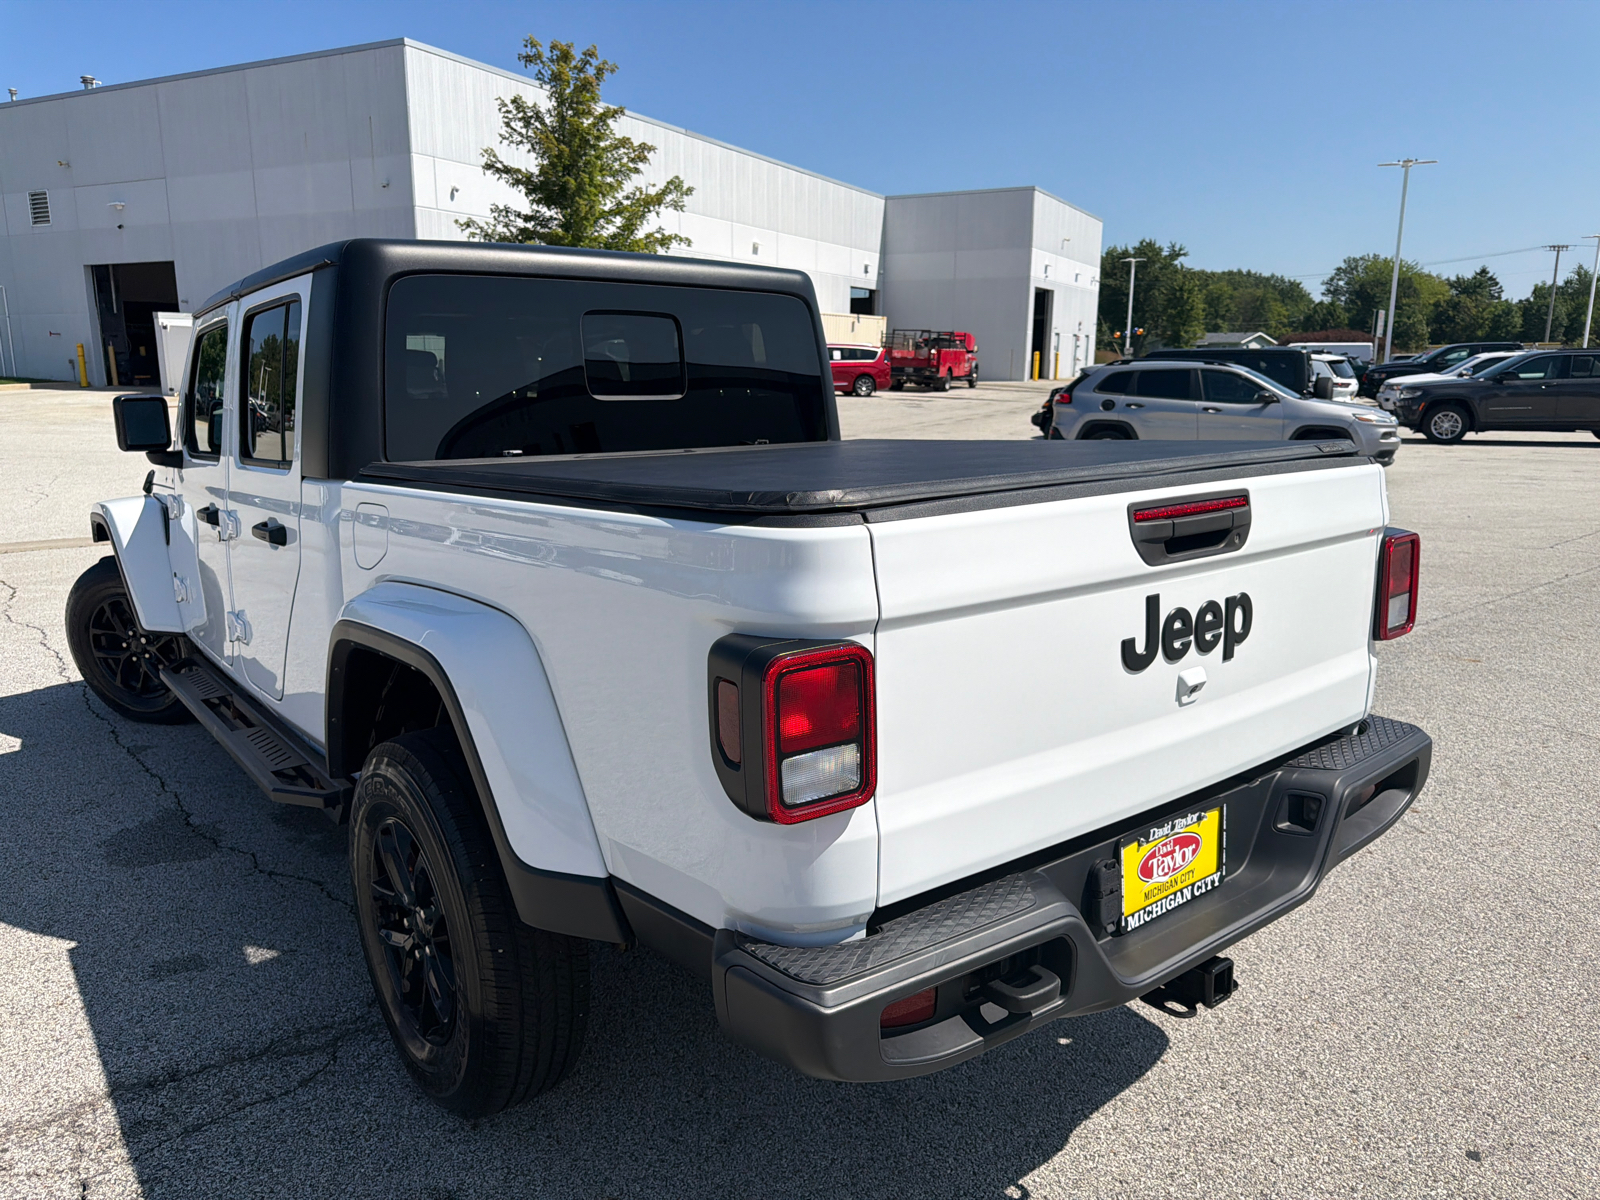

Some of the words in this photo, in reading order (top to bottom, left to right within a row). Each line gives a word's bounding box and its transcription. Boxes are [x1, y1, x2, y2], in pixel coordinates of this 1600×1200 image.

[1121, 592, 1252, 673] Jeep
[1149, 822, 1172, 841] David
[1173, 812, 1200, 833] Taylor
[1148, 843, 1196, 880] Taylor
[1155, 839, 1174, 857] David
[1127, 885, 1192, 931] MICHIGAN
[1194, 872, 1221, 896] CITY
[1144, 875, 1178, 902] MICHIGAN
[1179, 868, 1196, 884] CITY
